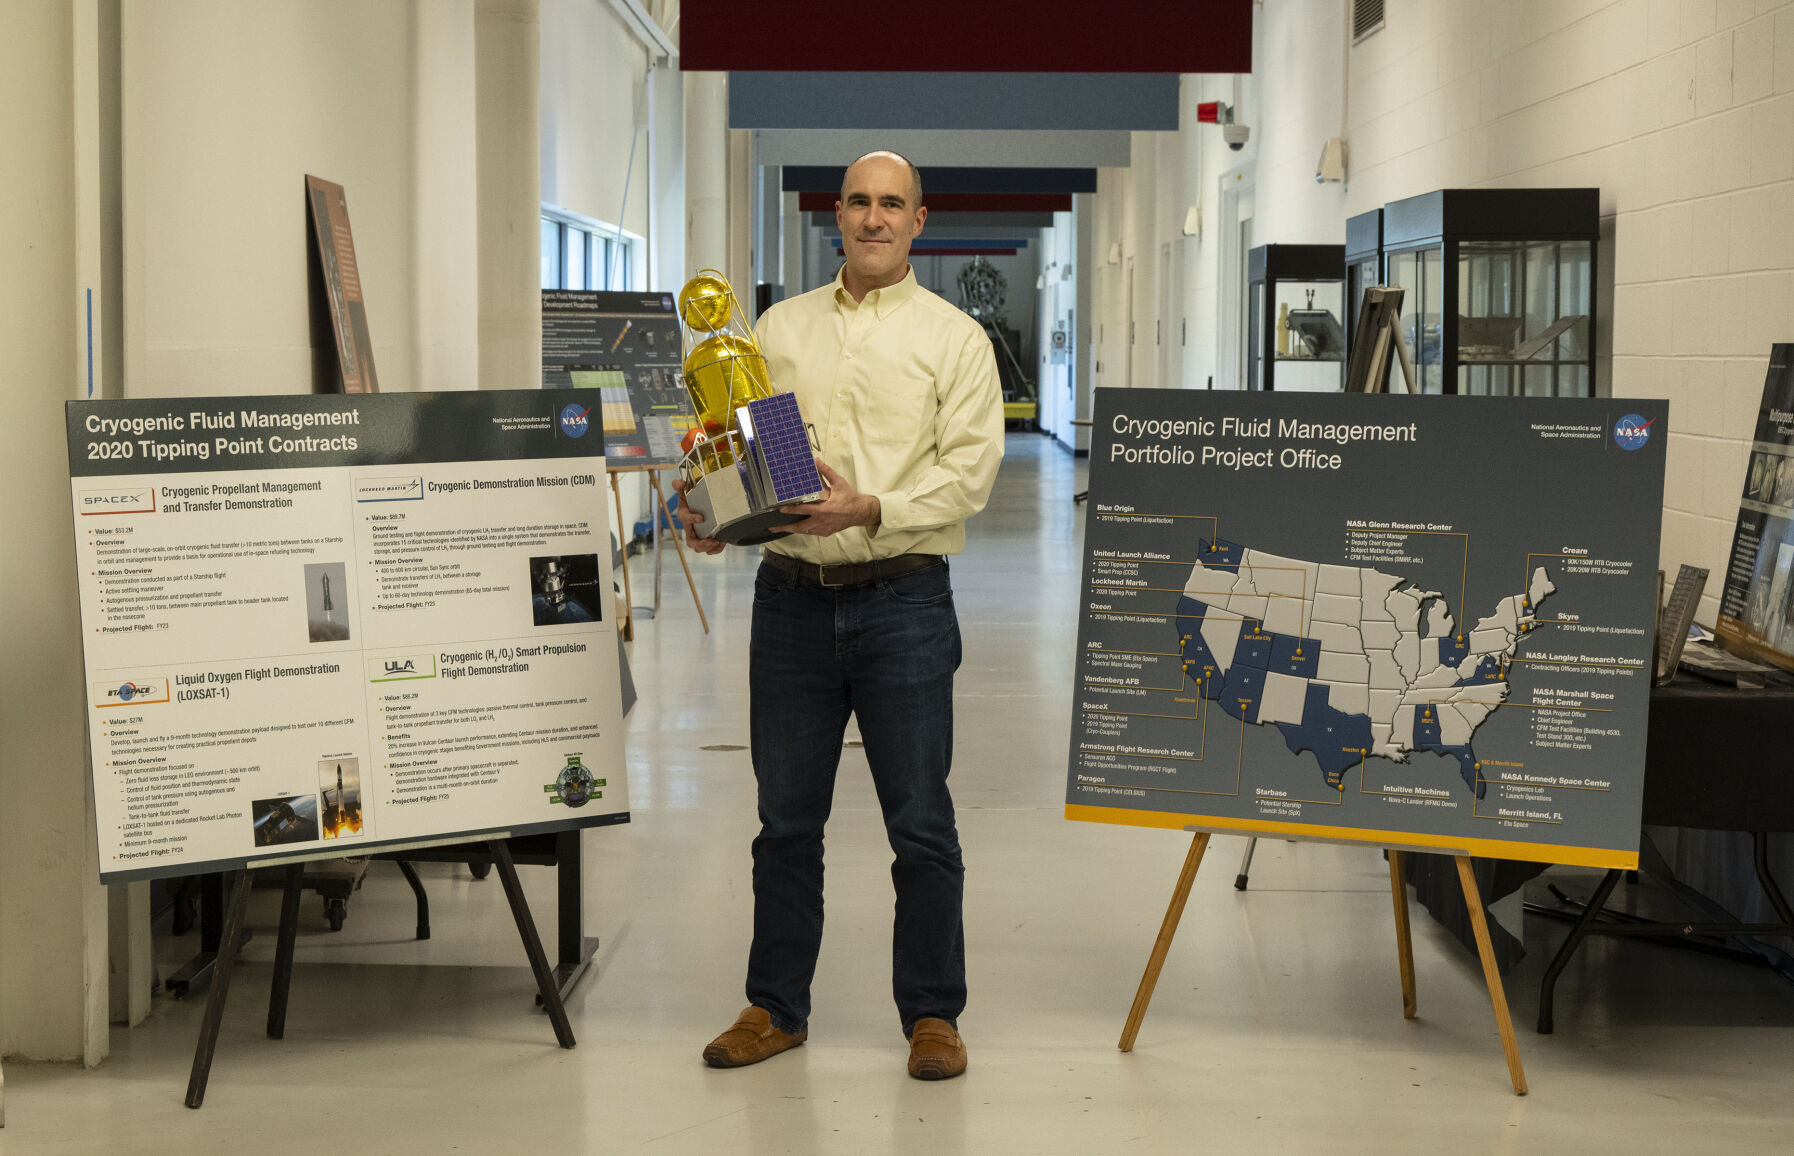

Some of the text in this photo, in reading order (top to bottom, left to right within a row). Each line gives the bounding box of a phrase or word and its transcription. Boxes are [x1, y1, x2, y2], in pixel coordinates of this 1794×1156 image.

[85, 408, 360, 436] Cryogenic Fluid Management
[1112, 414, 1417, 444] Cryogenic Fluid Management
[1559, 431, 1601, 439] Administration
[87, 434, 358, 461] 2020 Tipping Point Contracts
[1111, 443, 1342, 471] Portfolio Project Office
[428, 474, 595, 493] Cryogenic Demonstration Mission (CDM)
[161, 480, 322, 499] Cryogenic Propellant Management
[84, 493, 143, 504] SPACEX
[163, 497, 293, 513] and Transfer Demonstration
[1113, 504, 1135, 513] Origin
[1368, 520, 1390, 528] Glenn
[1391, 521, 1425, 530] Research
[1427, 523, 1452, 531] Center
[1351, 531, 1408, 541] Deputy Project Manager
[1351, 539, 1368, 547] Deputy
[1381, 540, 1403, 548] Engineer
[1093, 549, 1170, 560] United Launch Alliance
[1562, 546, 1588, 555] Creare
[1605, 559, 1633, 567] Cryocooler
[1091, 577, 1124, 585] Lockheed
[1090, 602, 1112, 610] Oxeon
[1557, 612, 1579, 621] Skyre
[102, 625, 133, 633] Projected
[1576, 625, 1595, 633] Tipping
[1087, 641, 1102, 649] ARC
[440, 650, 483, 665] Cryogenic
[515, 645, 541, 657] Smart
[542, 642, 587, 656] Propulsion
[1525, 651, 1644, 665] NASA Langley Research Center
[385, 660, 415, 671] ULA
[441, 662, 529, 680] Flight Demonstration
[175, 663, 340, 686] Liquid Oxygen Flight Demonstration
[1084, 675, 1140, 685] Vandenberg AFB
[177, 686, 230, 703] (LOXSAT-1)
[1533, 687, 1614, 700] NASA Marshall Space
[1082, 702, 1108, 710] SpaceX
[1532, 696, 1582, 707] Flight Center
[110, 729, 139, 737] Overview
[387, 733, 411, 741] Benefits
[1079, 742, 1195, 757] Armstrong Flight Research Center
[1535, 740, 1555, 748] Subject
[1572, 742, 1592, 750] Experts
[112, 756, 167, 767] Mission Overview
[1077, 774, 1106, 783] Paragon
[1501, 772, 1611, 787] NASA Kennedy Space Center
[1255, 787, 1287, 797] Starbase
[1383, 784, 1450, 796] Intuitive Machines
[392, 796, 419, 805] Projected
[1498, 808, 1563, 820] Merritt Island, FL
[119, 850, 149, 859] Projected
[150, 848, 170, 856] Flight:
